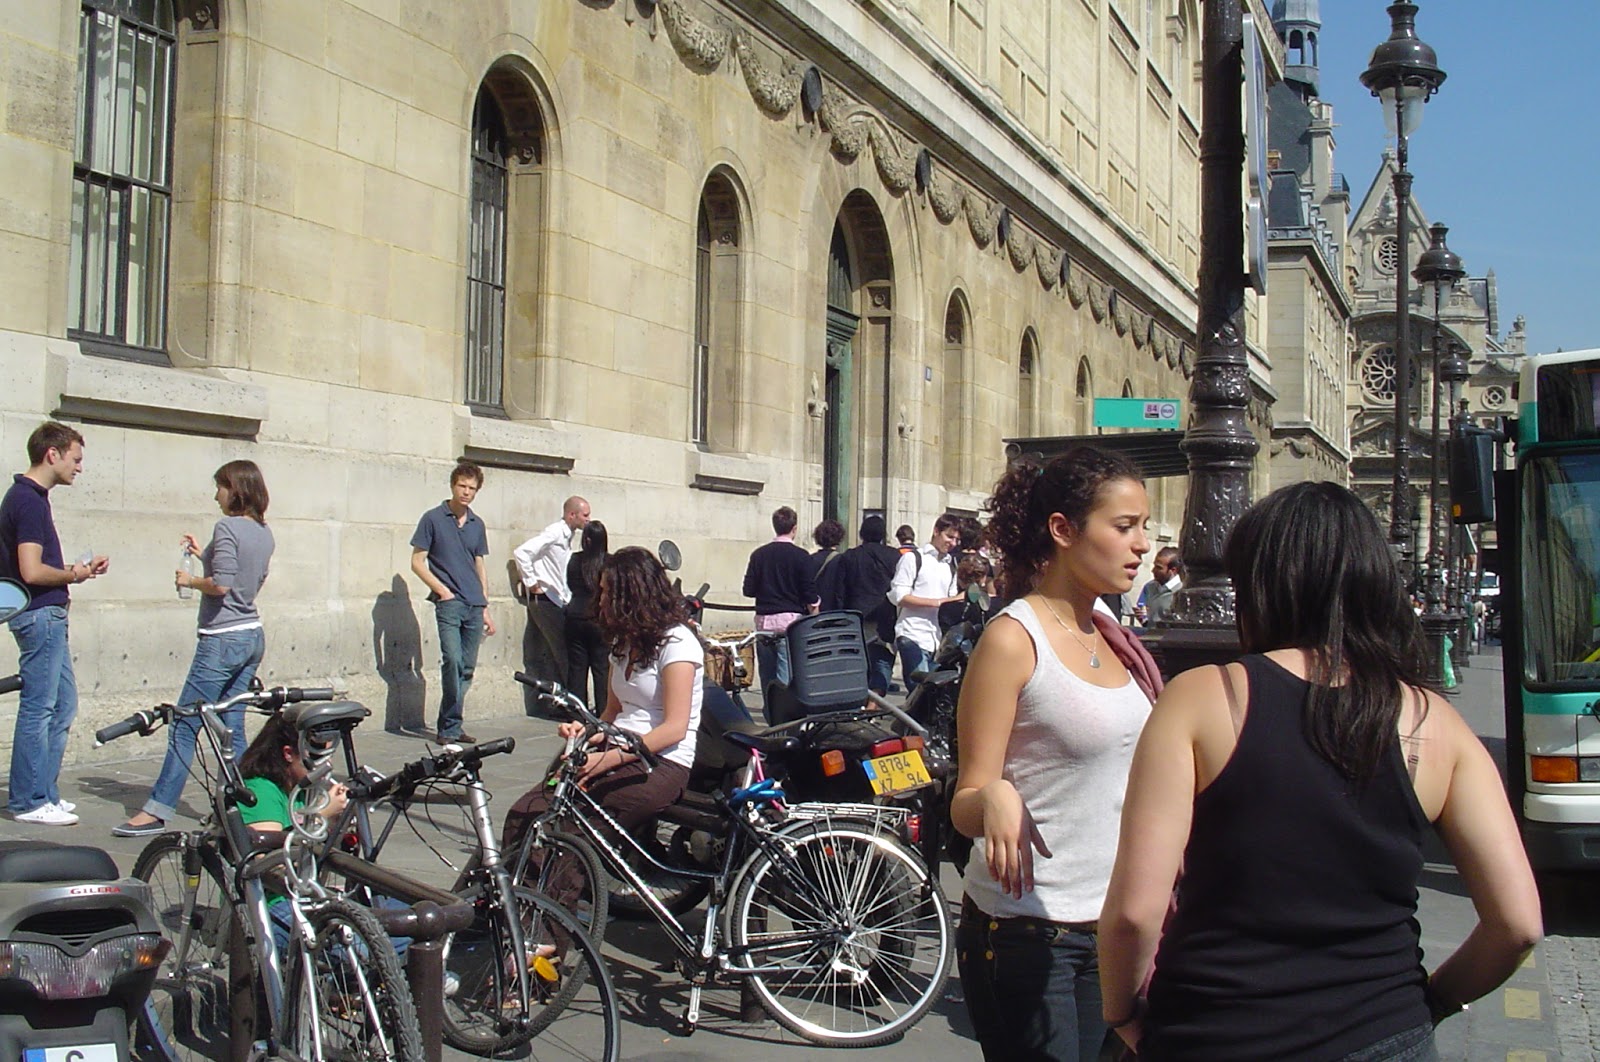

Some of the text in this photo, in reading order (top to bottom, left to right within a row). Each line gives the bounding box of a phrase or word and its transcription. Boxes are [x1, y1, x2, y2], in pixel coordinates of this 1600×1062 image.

[878, 755, 910, 774] 8784
[906, 771, 924, 787] 94
[70, 886, 121, 895] GILERA
